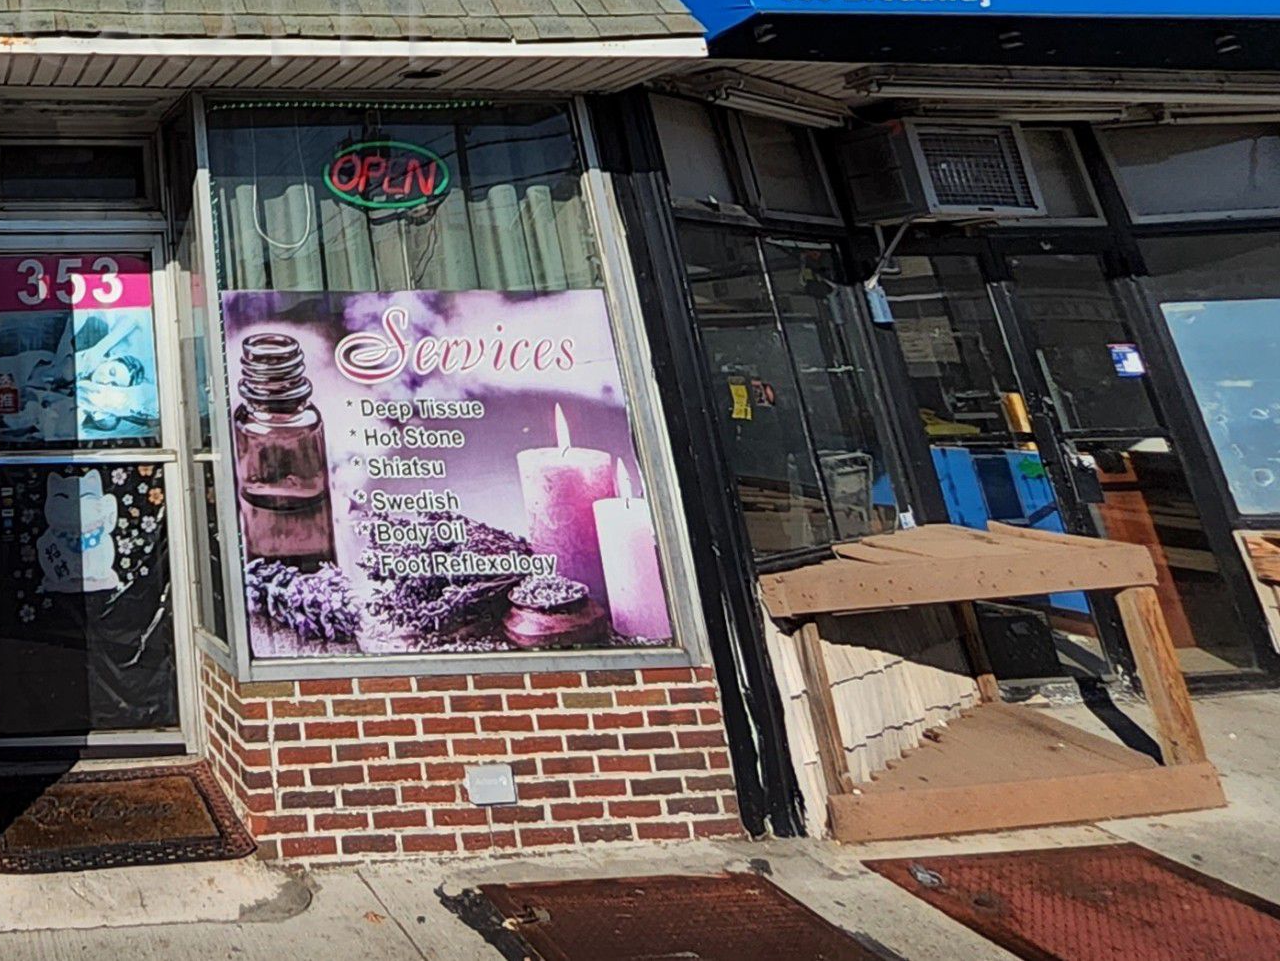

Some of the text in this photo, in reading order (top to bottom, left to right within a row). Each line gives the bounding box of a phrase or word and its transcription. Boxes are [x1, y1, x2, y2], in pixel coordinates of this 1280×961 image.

[17, 257, 123, 305] 353
[337, 308, 574, 383] Services
[361, 399, 484, 420] Deep Tissue
[364, 428, 465, 446] Hot Stone
[368, 458, 445, 477] Shiatsu
[373, 492, 459, 510] Swedish
[377, 522, 466, 546] Body Oil
[381, 553, 556, 575] Foot Reflexology
